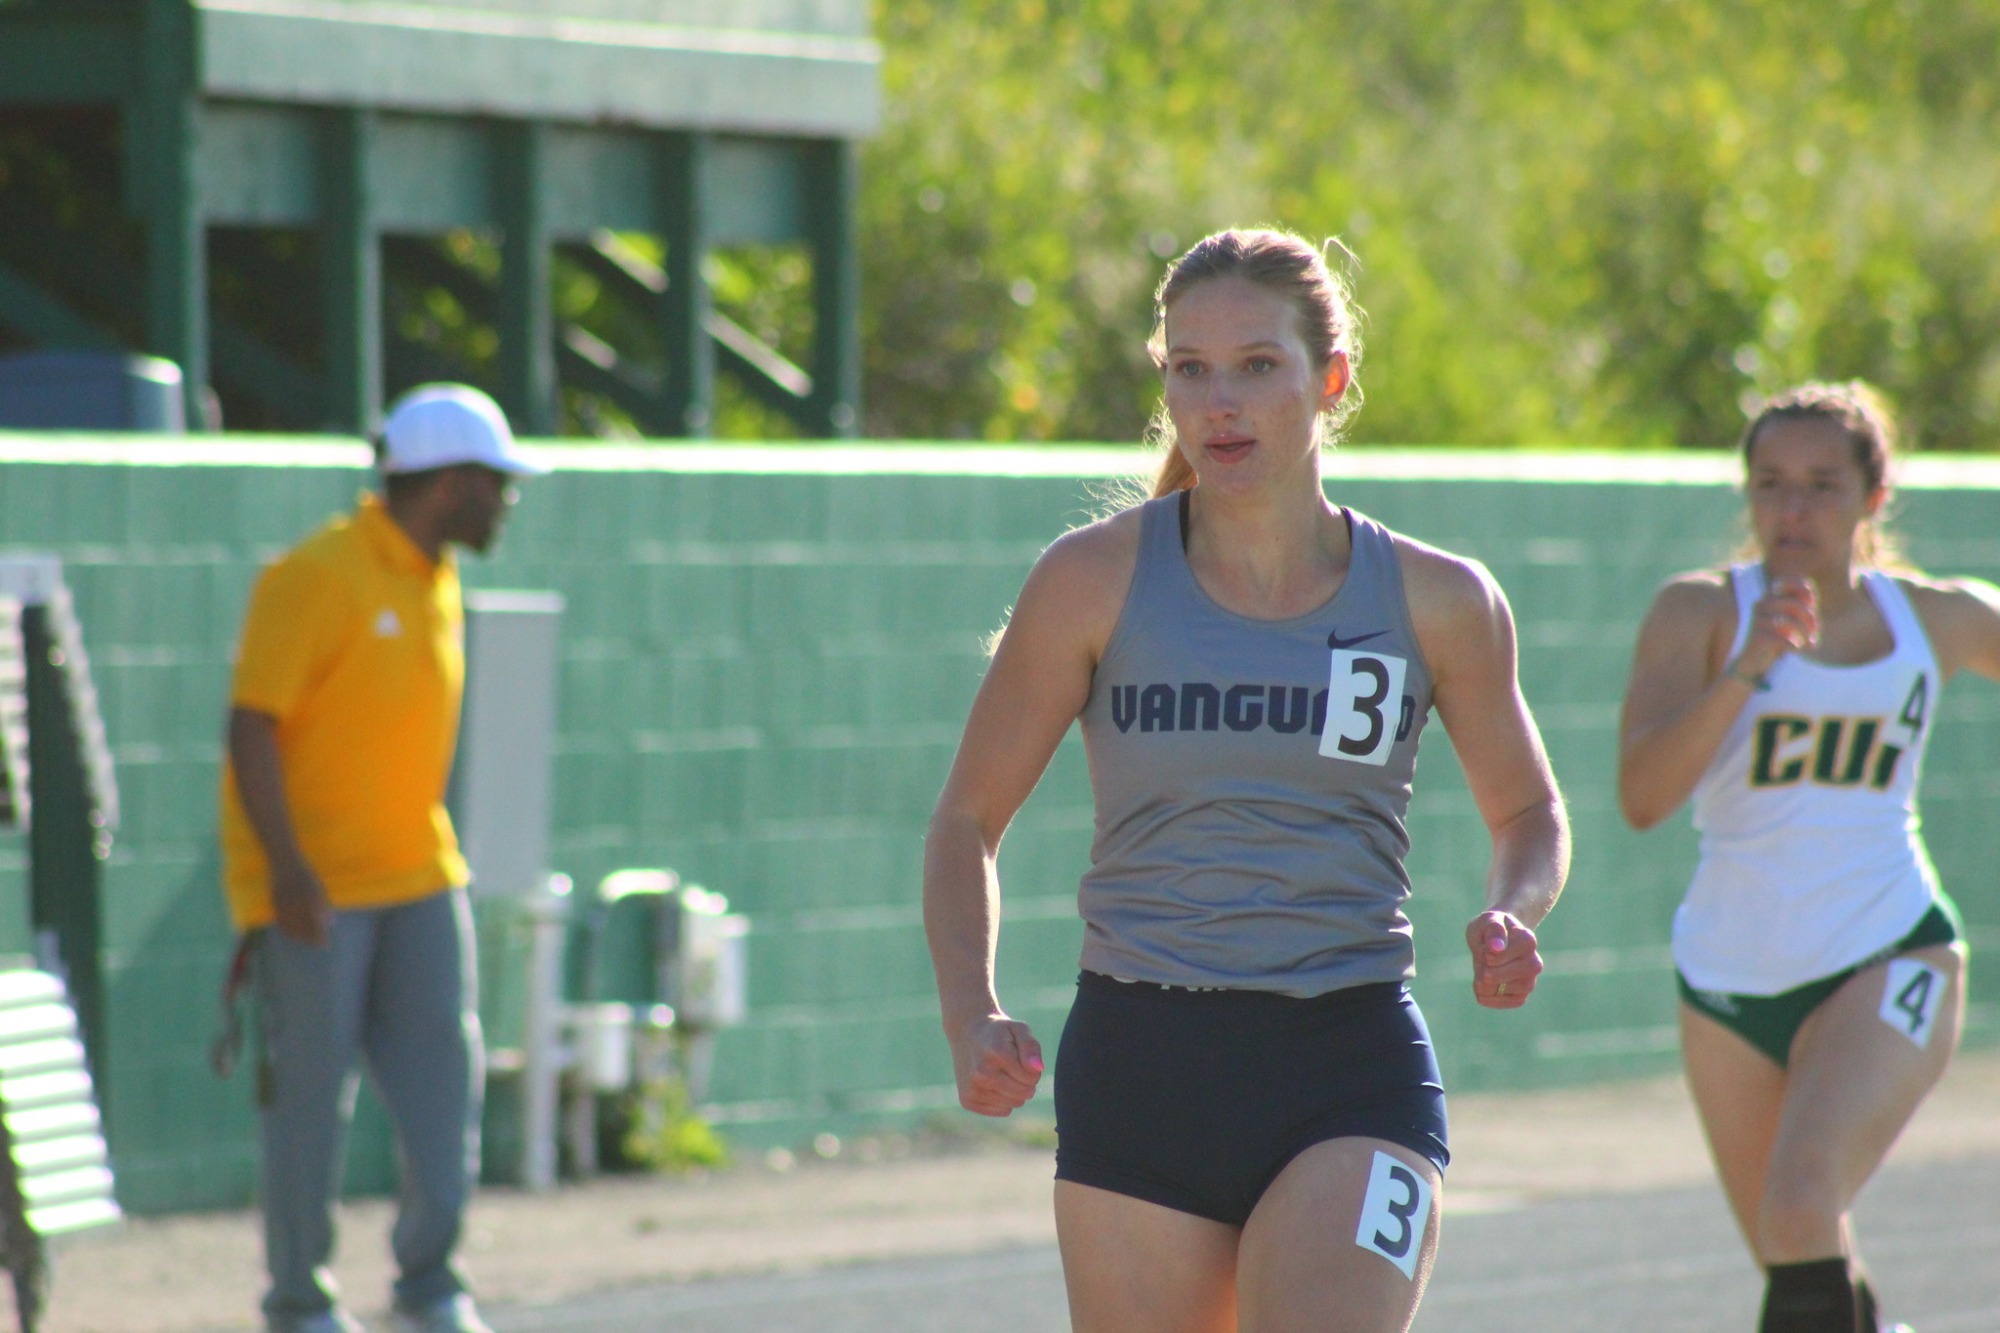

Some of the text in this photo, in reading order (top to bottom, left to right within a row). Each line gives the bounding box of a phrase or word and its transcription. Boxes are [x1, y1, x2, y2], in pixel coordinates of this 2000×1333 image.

[1111, 682, 1416, 742] VANGUD
[1338, 657, 1390, 757] 3
[1899, 671, 1926, 743] 4
[1894, 968, 1933, 1034] 4
[1373, 1165, 1420, 1259] 3
